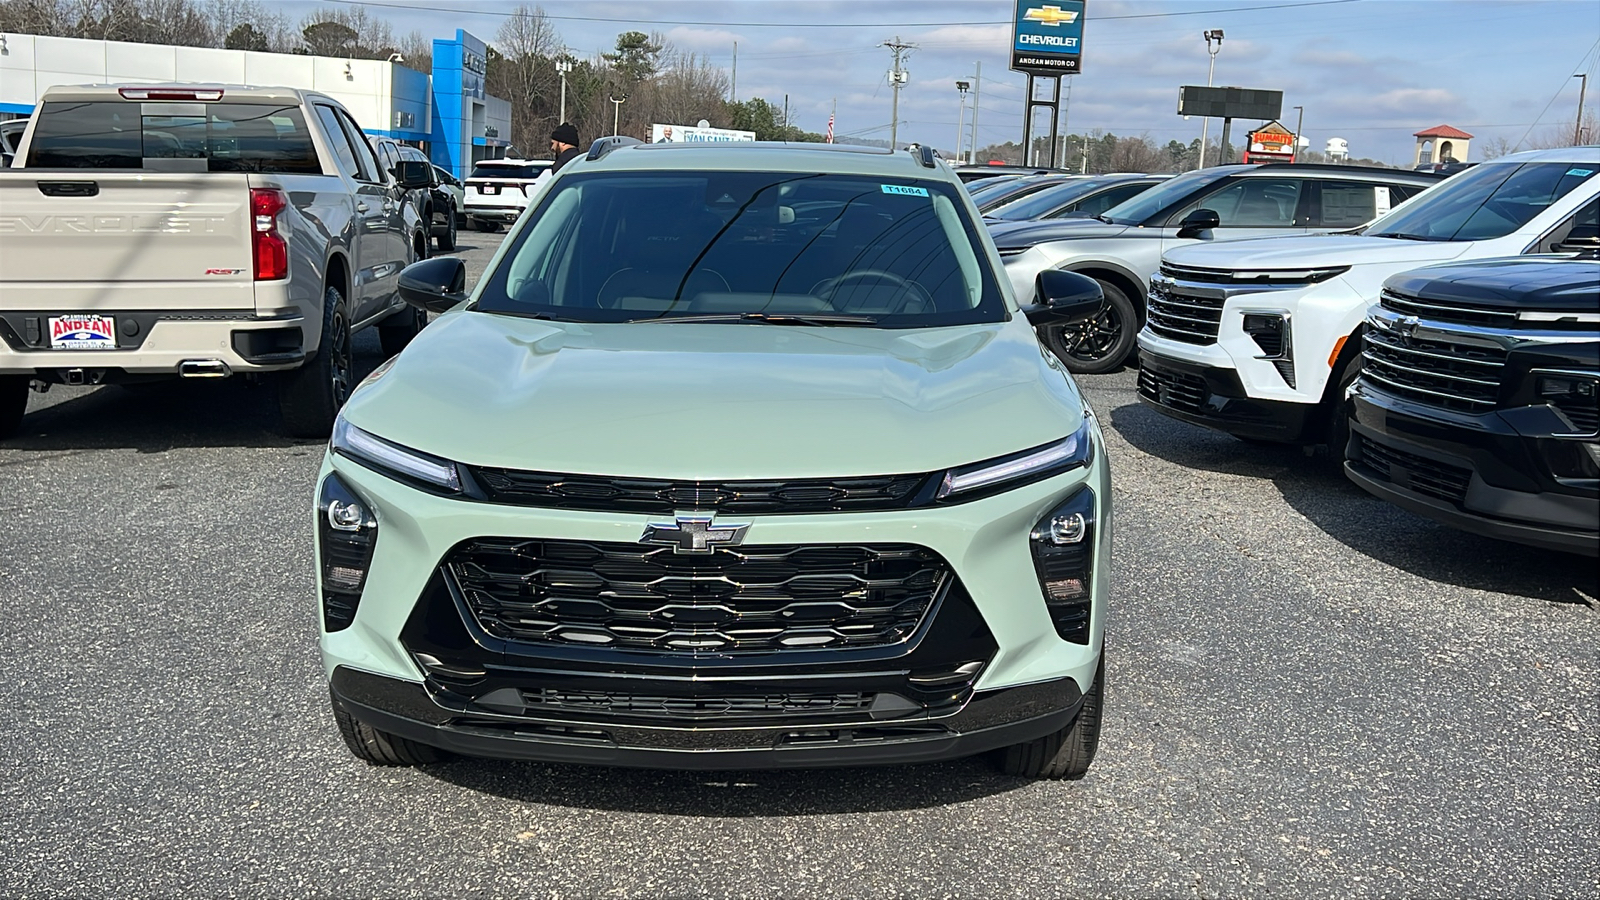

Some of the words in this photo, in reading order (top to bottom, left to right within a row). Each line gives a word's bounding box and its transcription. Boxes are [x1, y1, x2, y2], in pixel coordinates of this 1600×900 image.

[1019, 34, 1078, 47] CHEVROLET
[1019, 57, 1044, 65] ANDEAN
[1253, 132, 1293, 145] SUMMITS
[205, 267, 246, 275] RST
[53, 320, 113, 338] ANDEAN
